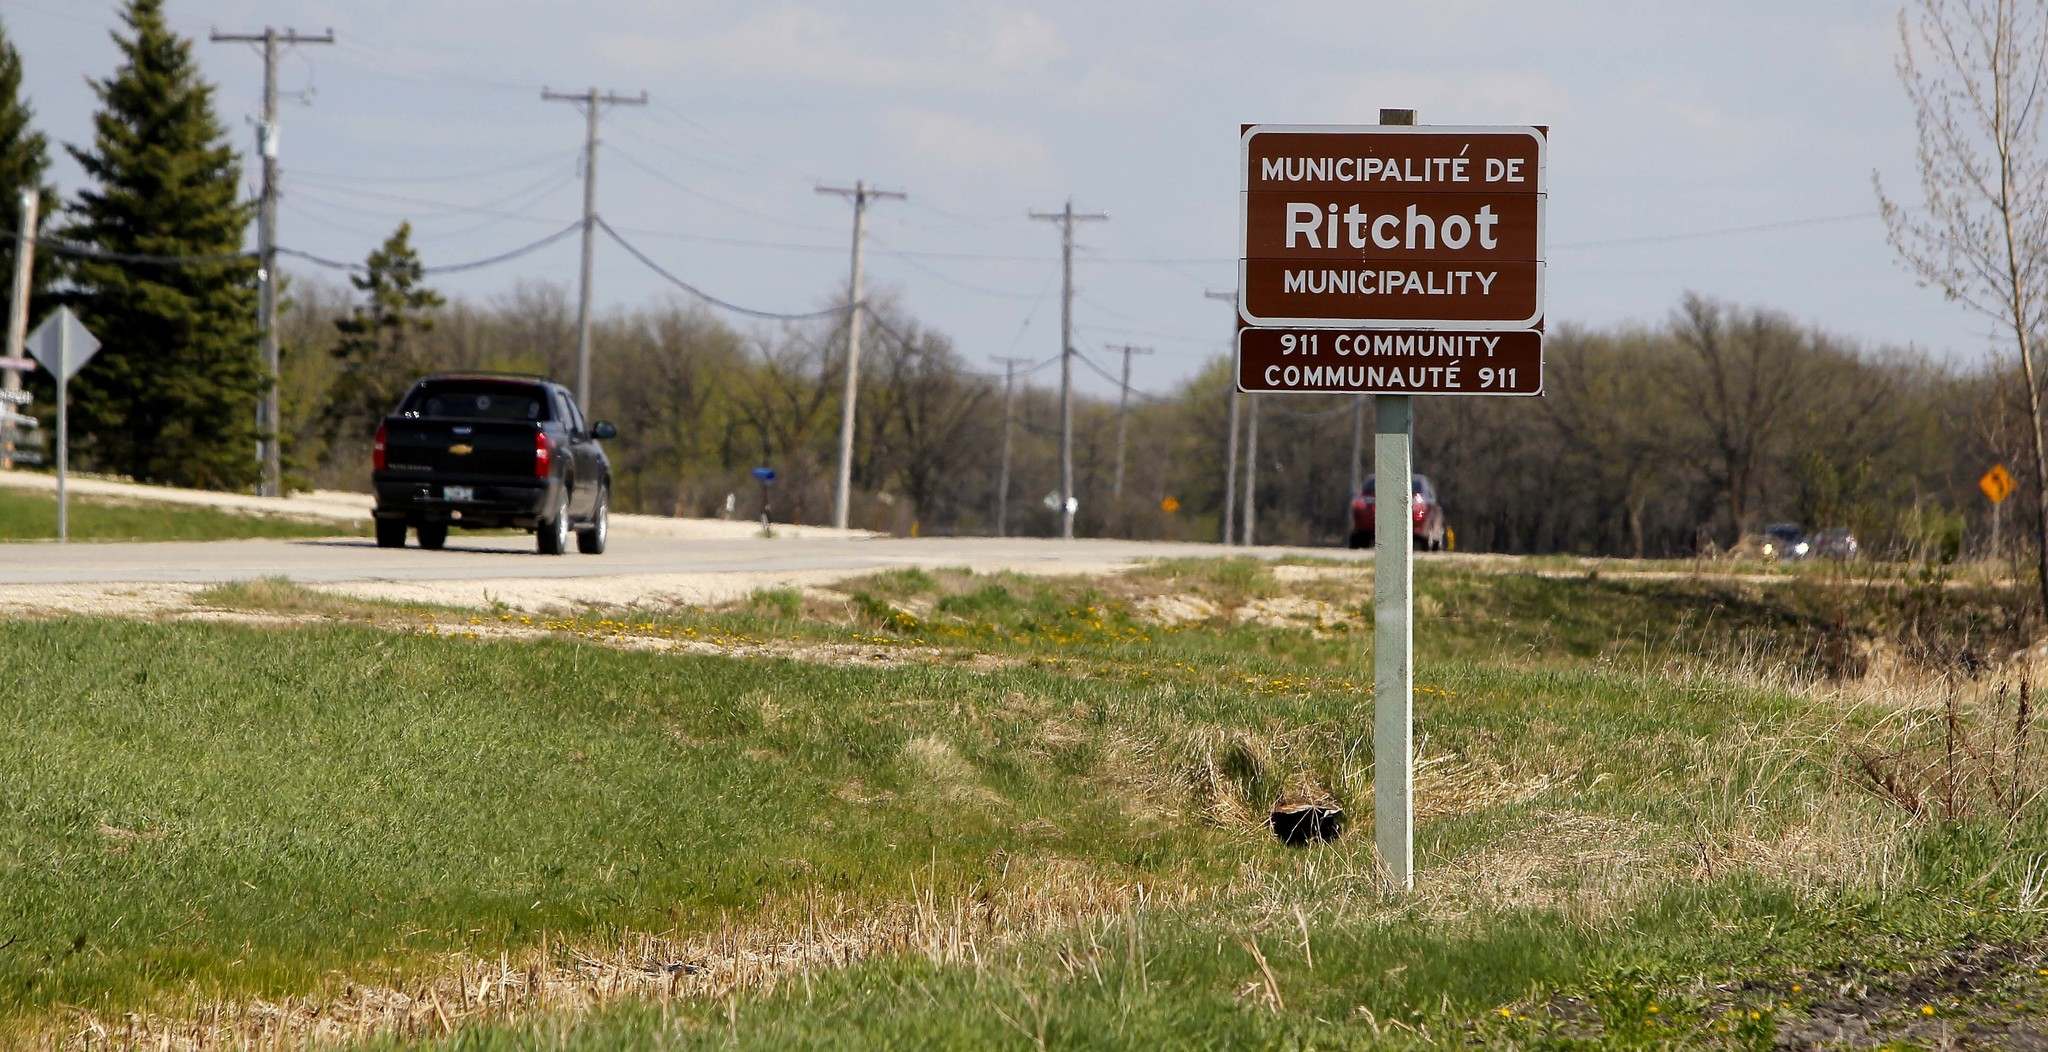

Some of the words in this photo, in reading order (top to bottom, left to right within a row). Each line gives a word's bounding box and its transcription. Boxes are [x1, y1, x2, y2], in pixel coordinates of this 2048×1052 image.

[1262, 144, 1469, 182] MUNICIPALITÉ
[1485, 159, 1524, 182] DE
[1285, 203, 1498, 249] Ritchot
[1284, 270, 1497, 294] MUNICIPALITY
[1280, 334, 1318, 356] 911
[1335, 335, 1500, 356] COMMUNITY
[1264, 360, 1460, 388] COMMUNAUTÉ
[1478, 368, 1516, 388] 911
